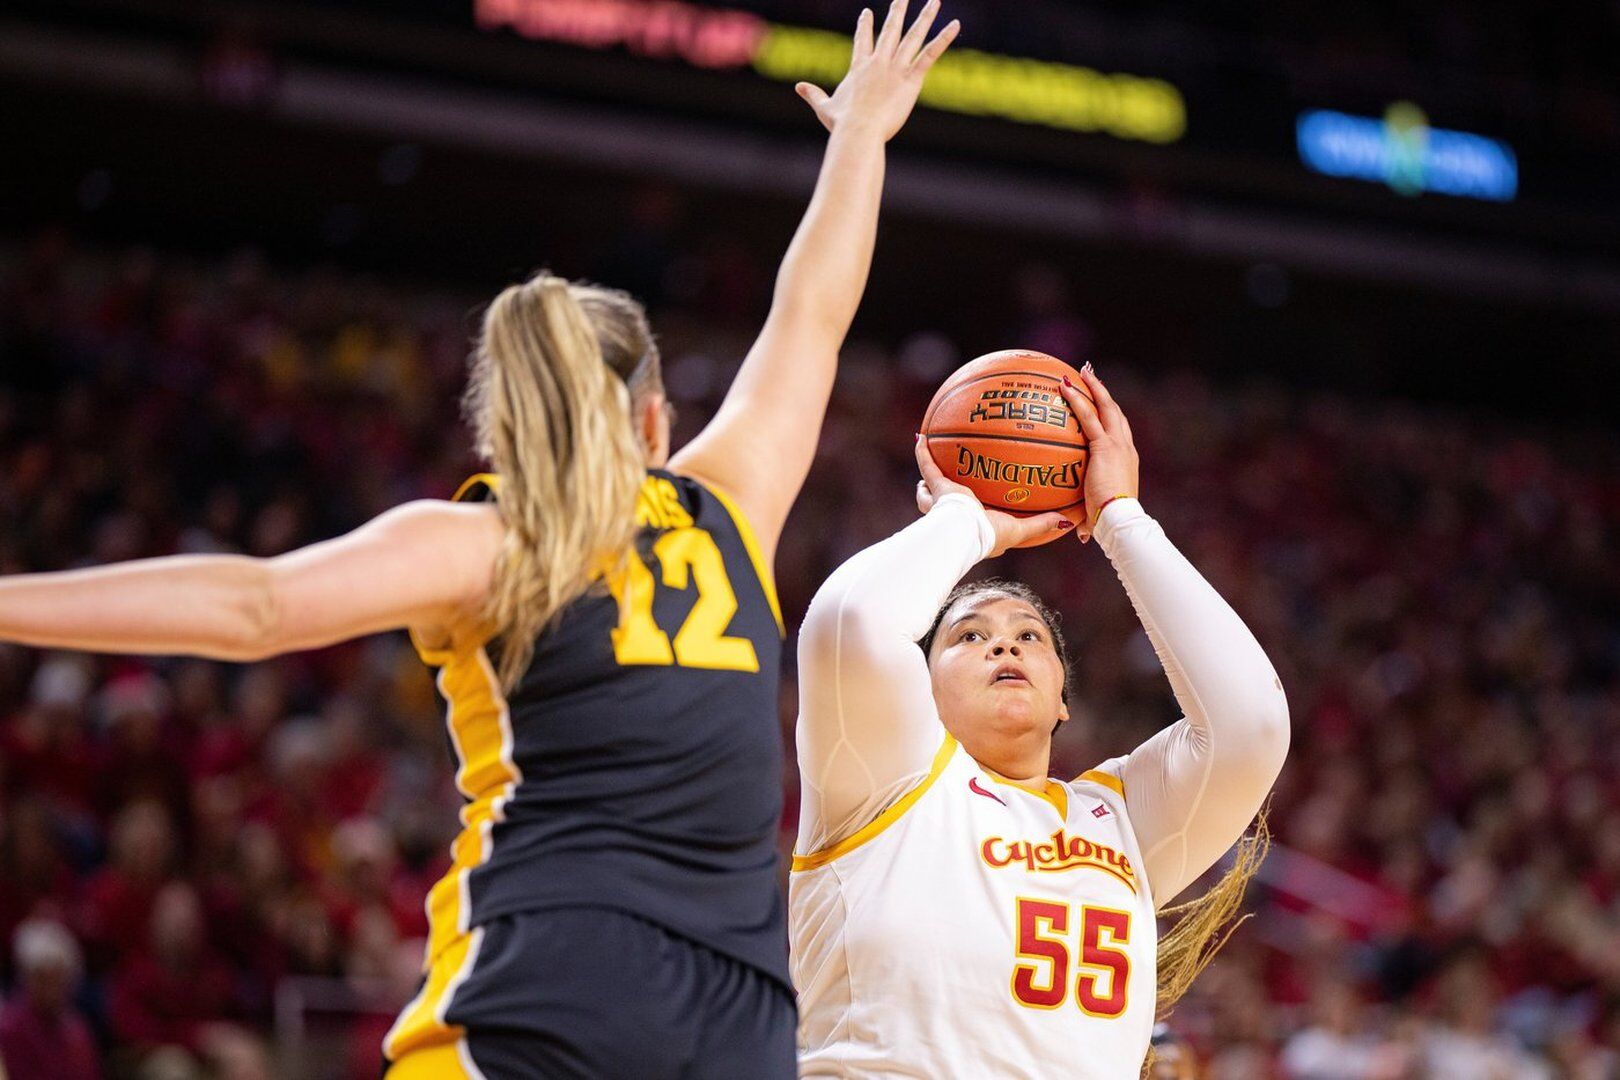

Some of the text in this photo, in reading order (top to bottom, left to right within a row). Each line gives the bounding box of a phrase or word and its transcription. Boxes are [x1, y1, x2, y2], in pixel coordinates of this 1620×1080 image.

[956, 445, 1083, 489] SPALDING
[589, 527, 760, 673] 12
[981, 828, 1138, 877] Cyclone
[1010, 896, 1132, 1020] 55
